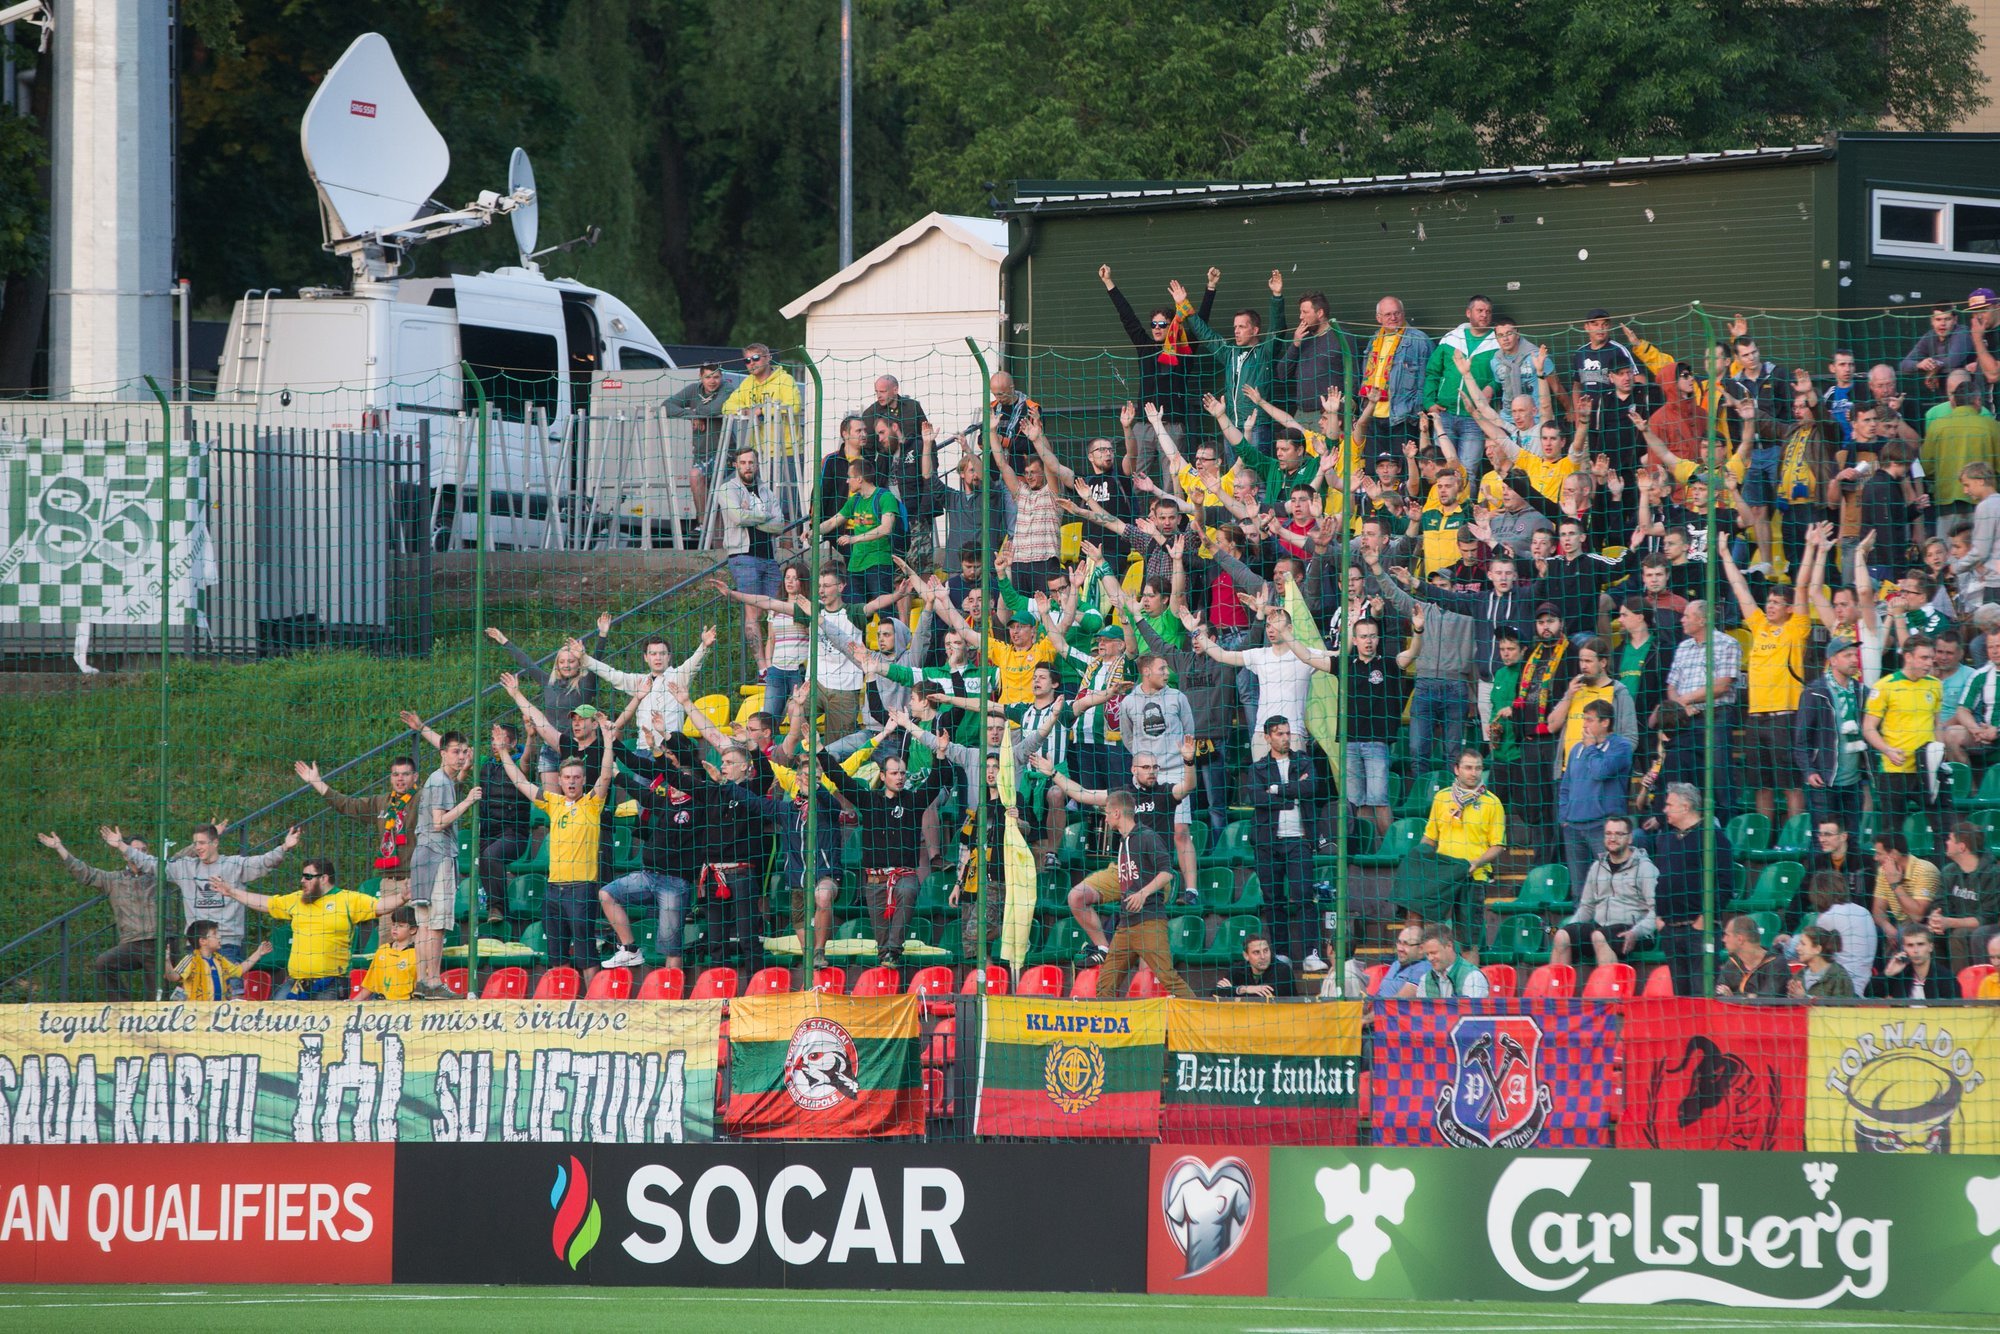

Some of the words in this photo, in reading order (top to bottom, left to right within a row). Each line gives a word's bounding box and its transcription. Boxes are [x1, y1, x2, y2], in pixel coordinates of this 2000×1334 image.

[36, 476, 156, 567] 85
[40, 1005, 111, 1043] tegul
[205, 1003, 330, 1033] Lietuvos
[346, 1005, 412, 1041] dega
[1026, 1013, 1131, 1034] KLAIPĖDA
[114, 1052, 260, 1142] KARTU
[431, 1050, 492, 1142] SU
[502, 1048, 686, 1143] LIETUVA
[1272, 1057, 1357, 1095] tankai
[88, 1182, 373, 1252] QUALIFIERS
[621, 1163, 966, 1266] SOCAR
[1487, 1156, 1893, 1300] Carlsberg
